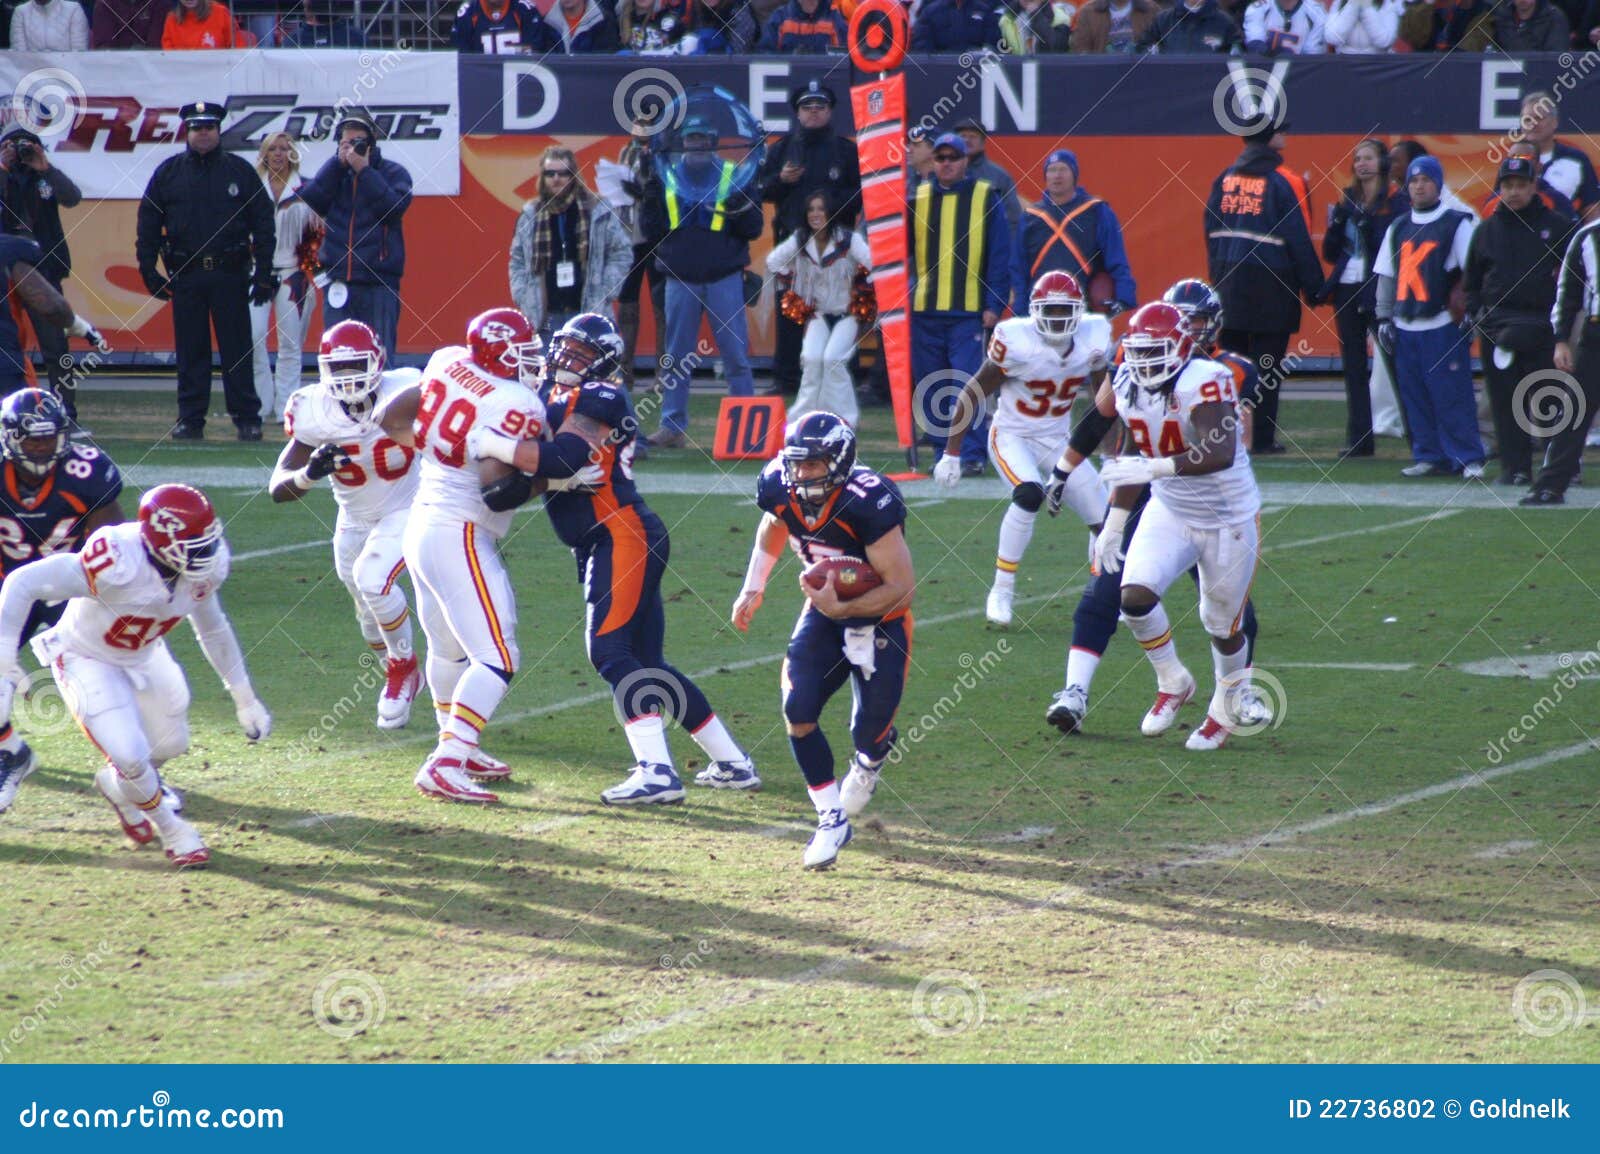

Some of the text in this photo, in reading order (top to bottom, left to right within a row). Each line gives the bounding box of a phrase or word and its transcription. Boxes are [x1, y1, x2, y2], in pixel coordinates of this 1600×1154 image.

[1397, 241, 1439, 302] K
[444, 361, 496, 398] GORDON
[414, 378, 478, 470] 99
[500, 409, 542, 440] 99
[726, 405, 772, 454] 10
[846, 470, 881, 499] 15
[83, 536, 114, 578] 91
